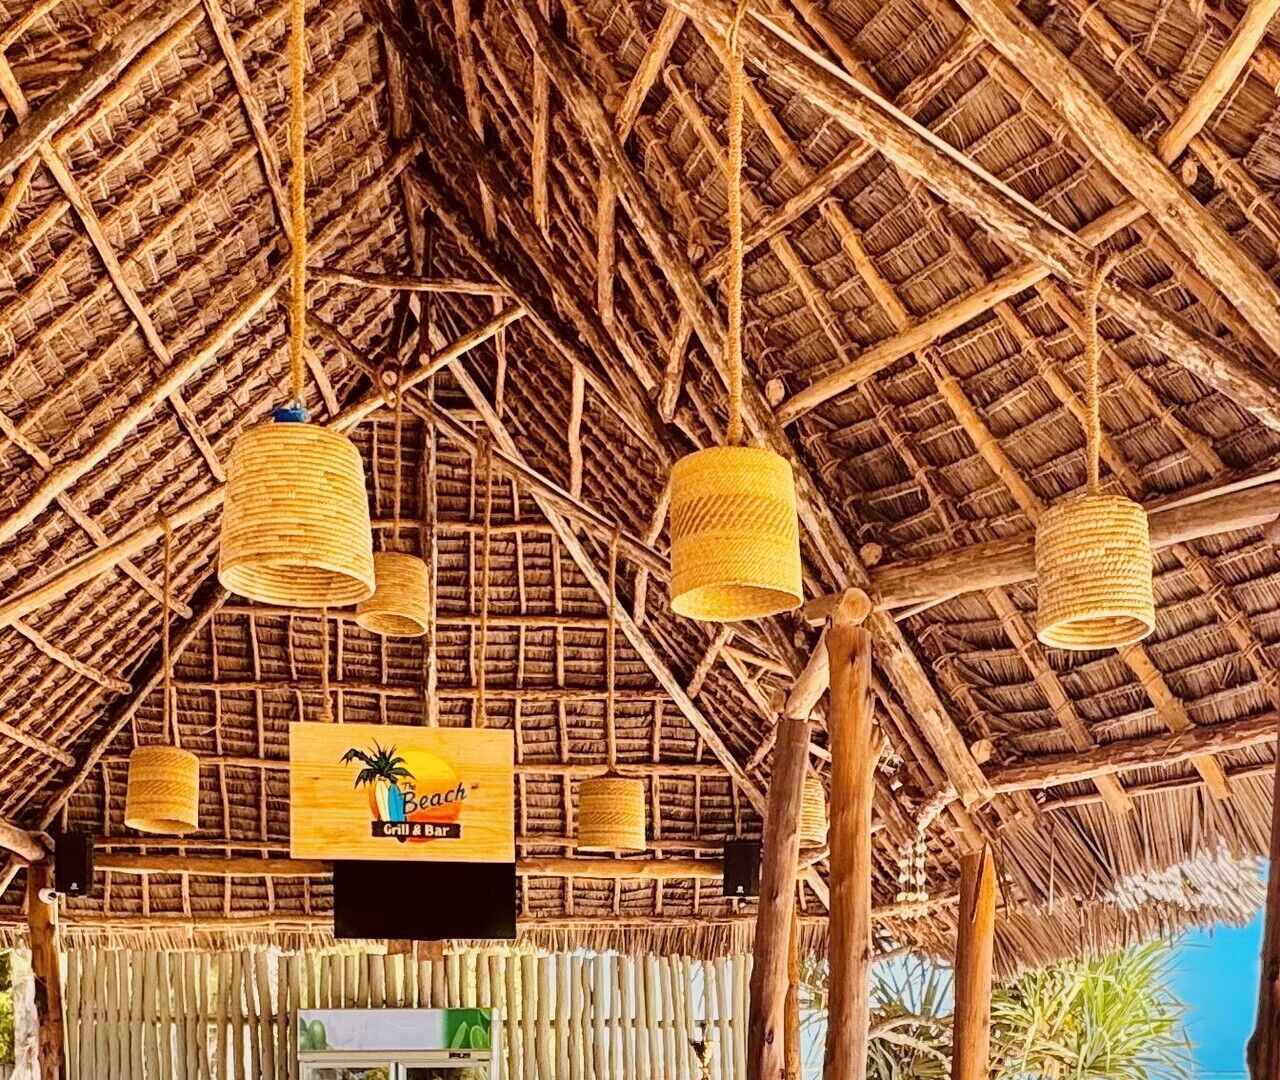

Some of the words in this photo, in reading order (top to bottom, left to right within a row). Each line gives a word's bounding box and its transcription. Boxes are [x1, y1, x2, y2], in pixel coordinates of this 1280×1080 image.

[401, 782, 467, 815] Beach
[383, 824, 410, 836] Grill
[412, 824, 422, 836] &
[424, 824, 450, 837] Bar
